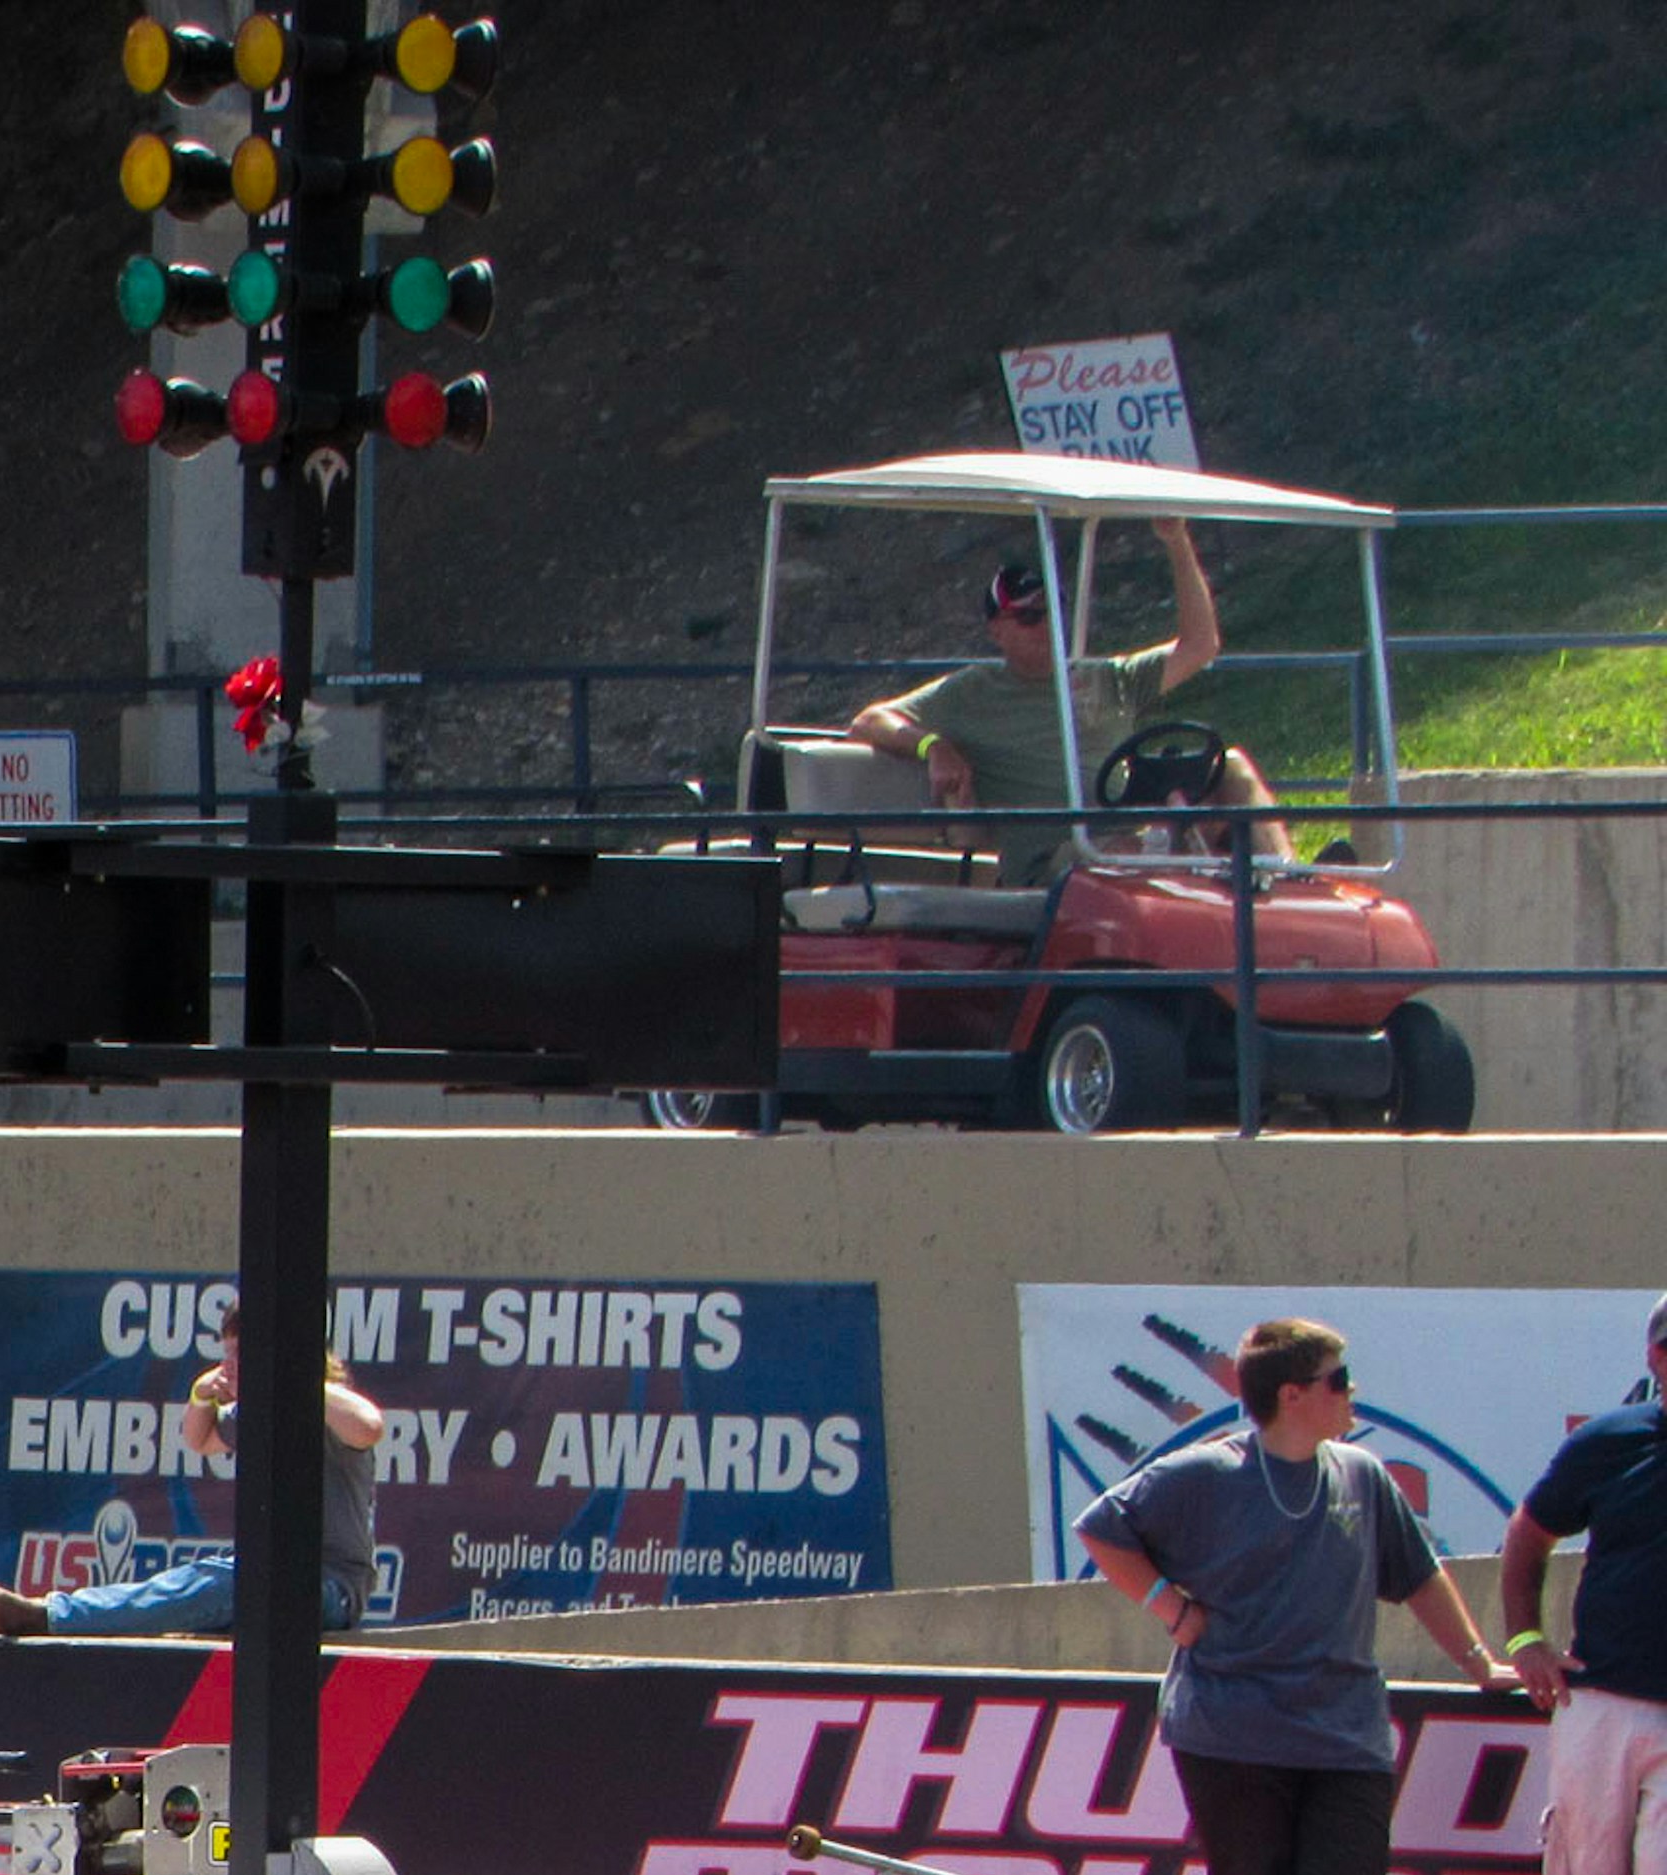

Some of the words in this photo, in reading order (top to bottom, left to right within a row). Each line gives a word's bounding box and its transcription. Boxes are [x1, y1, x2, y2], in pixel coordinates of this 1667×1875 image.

[1010, 351, 1173, 403] Please
[1020, 400, 1099, 444] STAY
[1117, 390, 1184, 432] OFF
[1, 752, 29, 782] NO
[100, 1280, 400, 1363] CUSM
[421, 1287, 743, 1371] T-SHIRTS
[6, 1397, 471, 1485] EMBRRY
[536, 1411, 862, 1497] AWARDS
[450, 1532, 554, 1578] Supplier
[559, 1539, 583, 1572] to
[589, 1535, 723, 1577] Bandimere
[730, 1539, 864, 1588] Speedway
